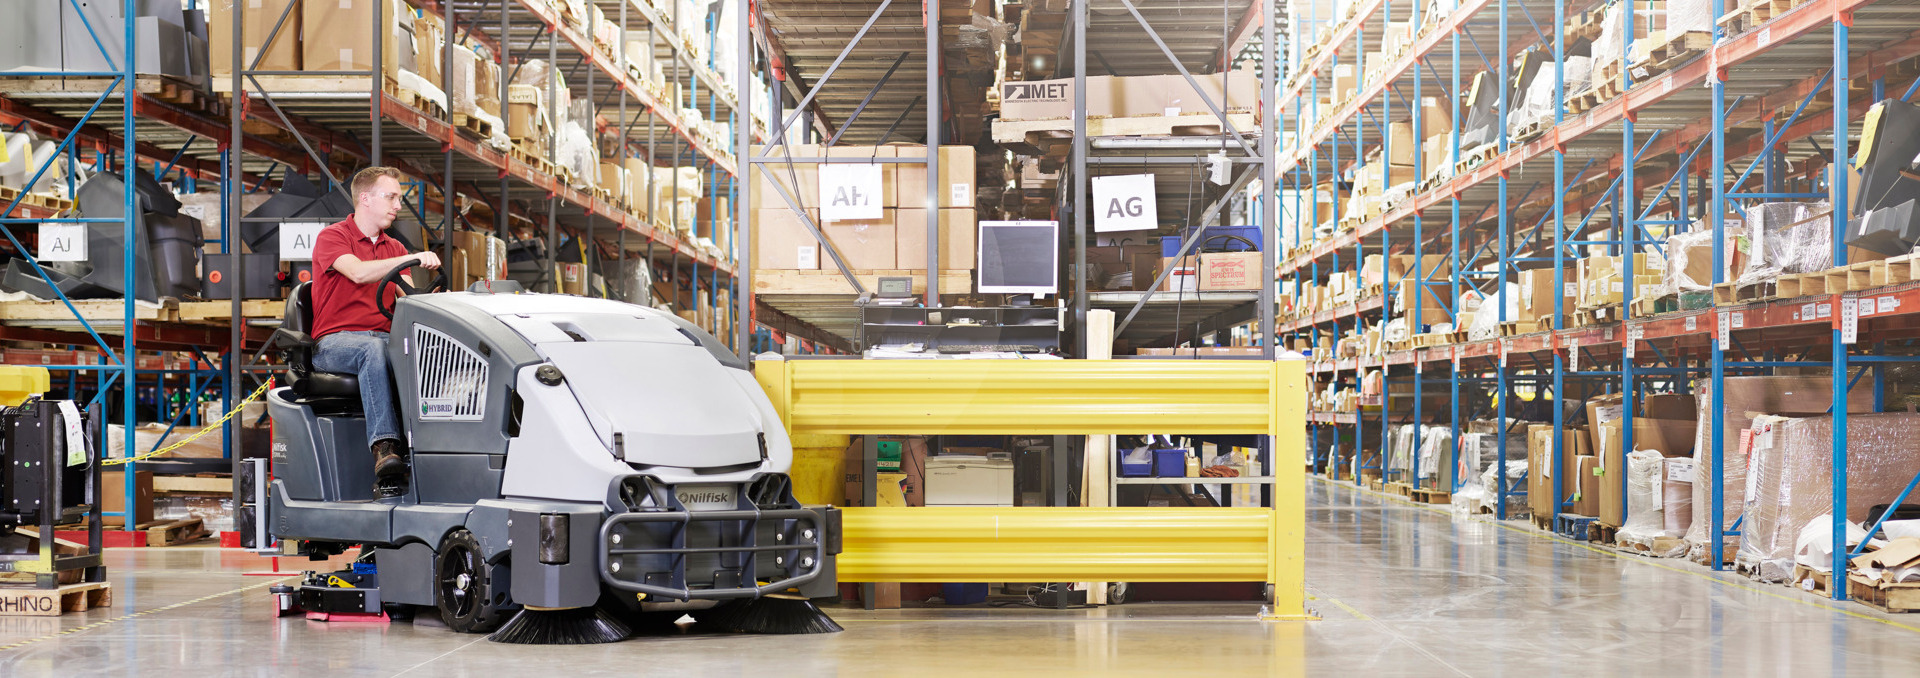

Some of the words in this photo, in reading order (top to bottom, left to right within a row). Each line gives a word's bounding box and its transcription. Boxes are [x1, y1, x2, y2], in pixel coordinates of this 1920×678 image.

[1031, 83, 1068, 99] MET
[832, 185, 868, 206] AH
[1106, 196, 1143, 218] AG
[51, 237, 71, 252] AJ
[293, 233, 311, 249] AI
[1210, 271, 1245, 279] SPECTRUM
[428, 404, 453, 413] HYBRID
[690, 492, 728, 503] Nilfisk
[0, 596, 53, 612] HINO
